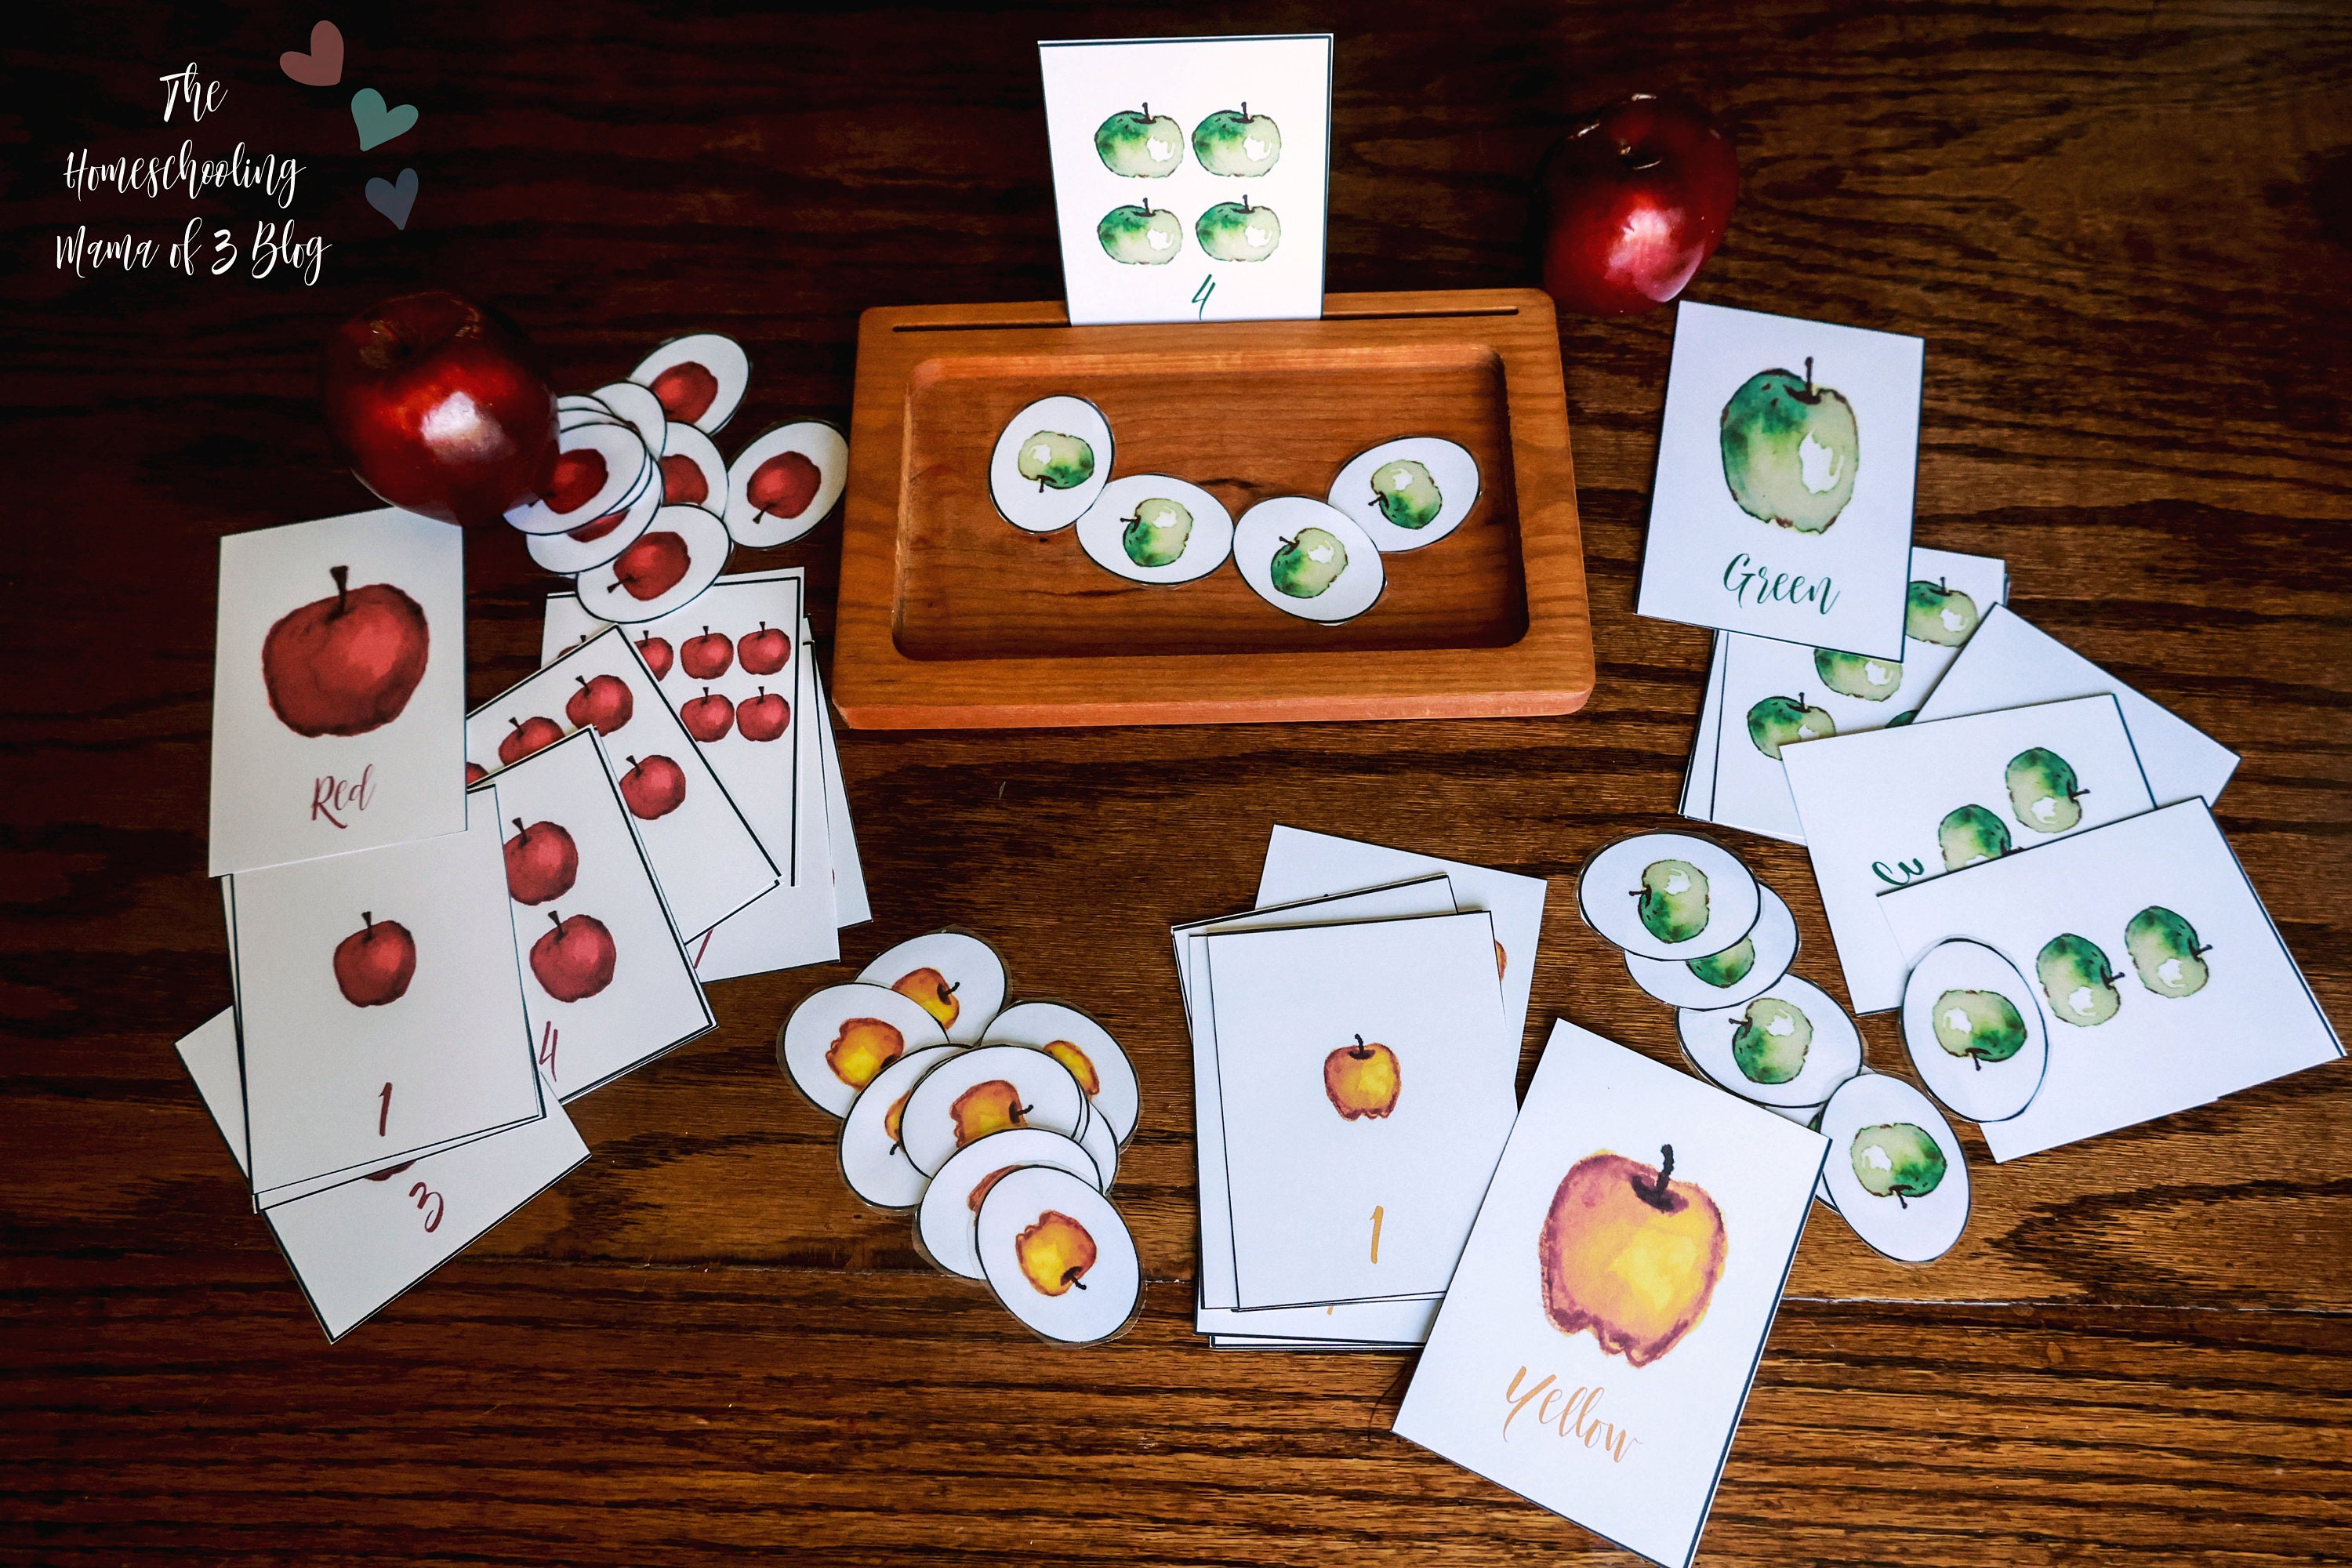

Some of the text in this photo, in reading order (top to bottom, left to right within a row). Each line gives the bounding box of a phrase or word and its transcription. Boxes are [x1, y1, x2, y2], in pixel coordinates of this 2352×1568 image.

[1191, 273, 1216, 321] 4
[1722, 553, 1841, 615] Green
[310, 763, 376, 829] Red
[539, 1020, 558, 1083] 4
[378, 1081, 393, 1138] 1
[408, 1181, 445, 1233] 3
[1369, 1204, 1384, 1265] 1
[1503, 1366, 1642, 1464] Yellow
